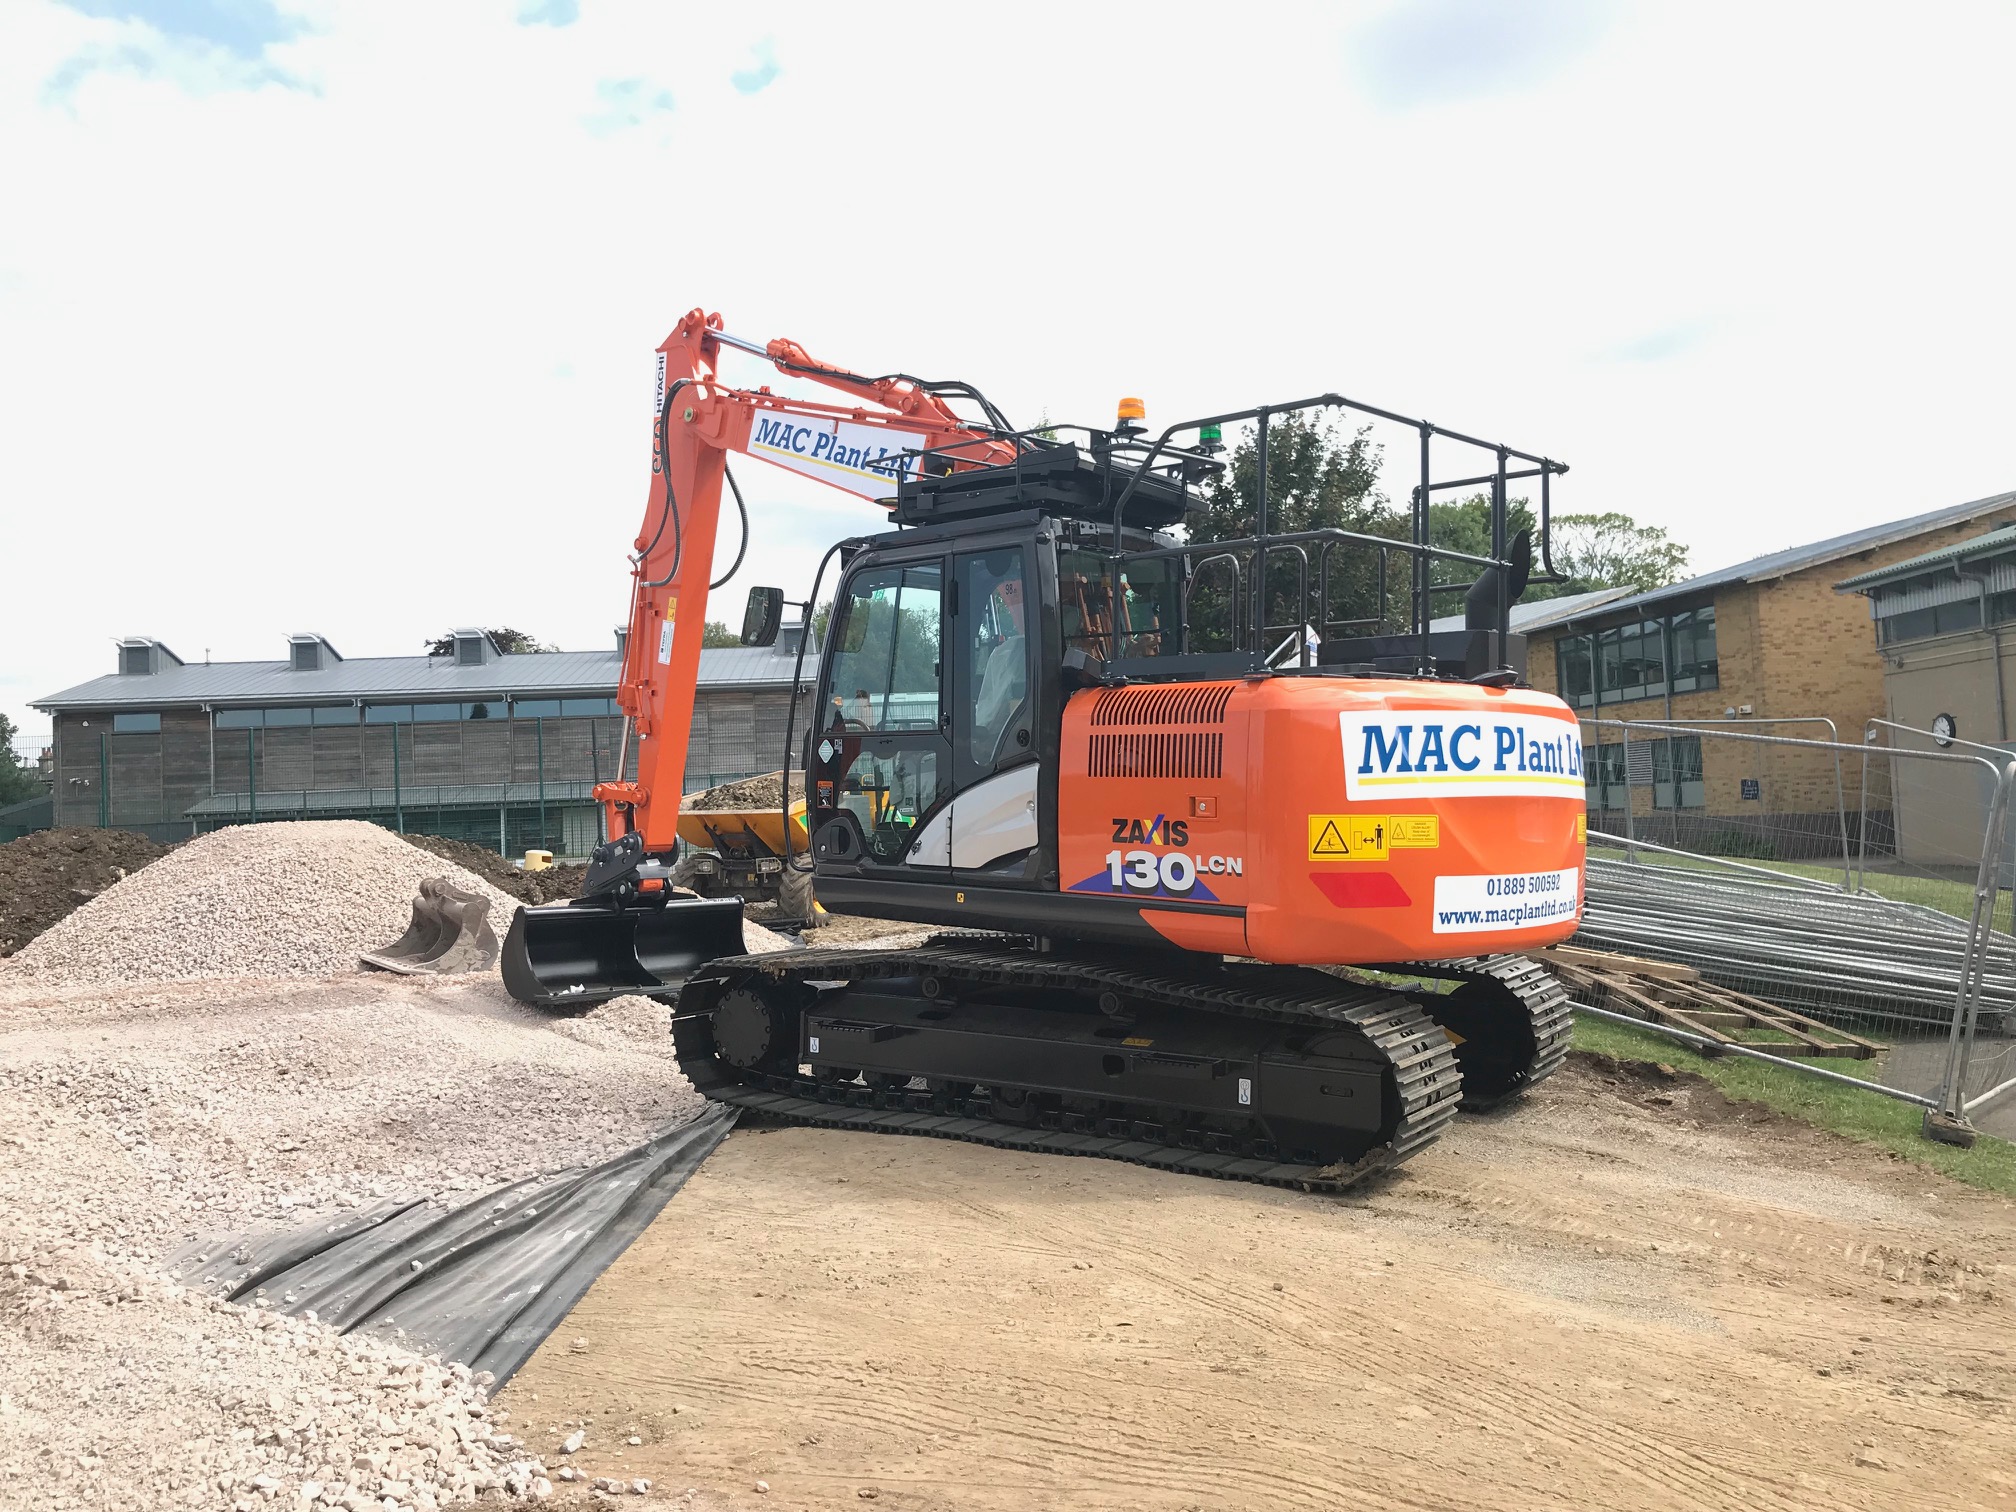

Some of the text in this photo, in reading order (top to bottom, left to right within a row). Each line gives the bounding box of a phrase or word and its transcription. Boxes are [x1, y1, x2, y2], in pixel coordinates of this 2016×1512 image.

[656, 356, 665, 413] HITACHI
[755, 418, 812, 453] MAC
[811, 432, 872, 470] Plant
[1358, 724, 1584, 777] MAC Plant Lt
[1112, 813, 1189, 847] ZAXIS
[1487, 873, 1561, 896] 01889 500592
[1438, 895, 1576, 926] www.macplantltd.co.uk
